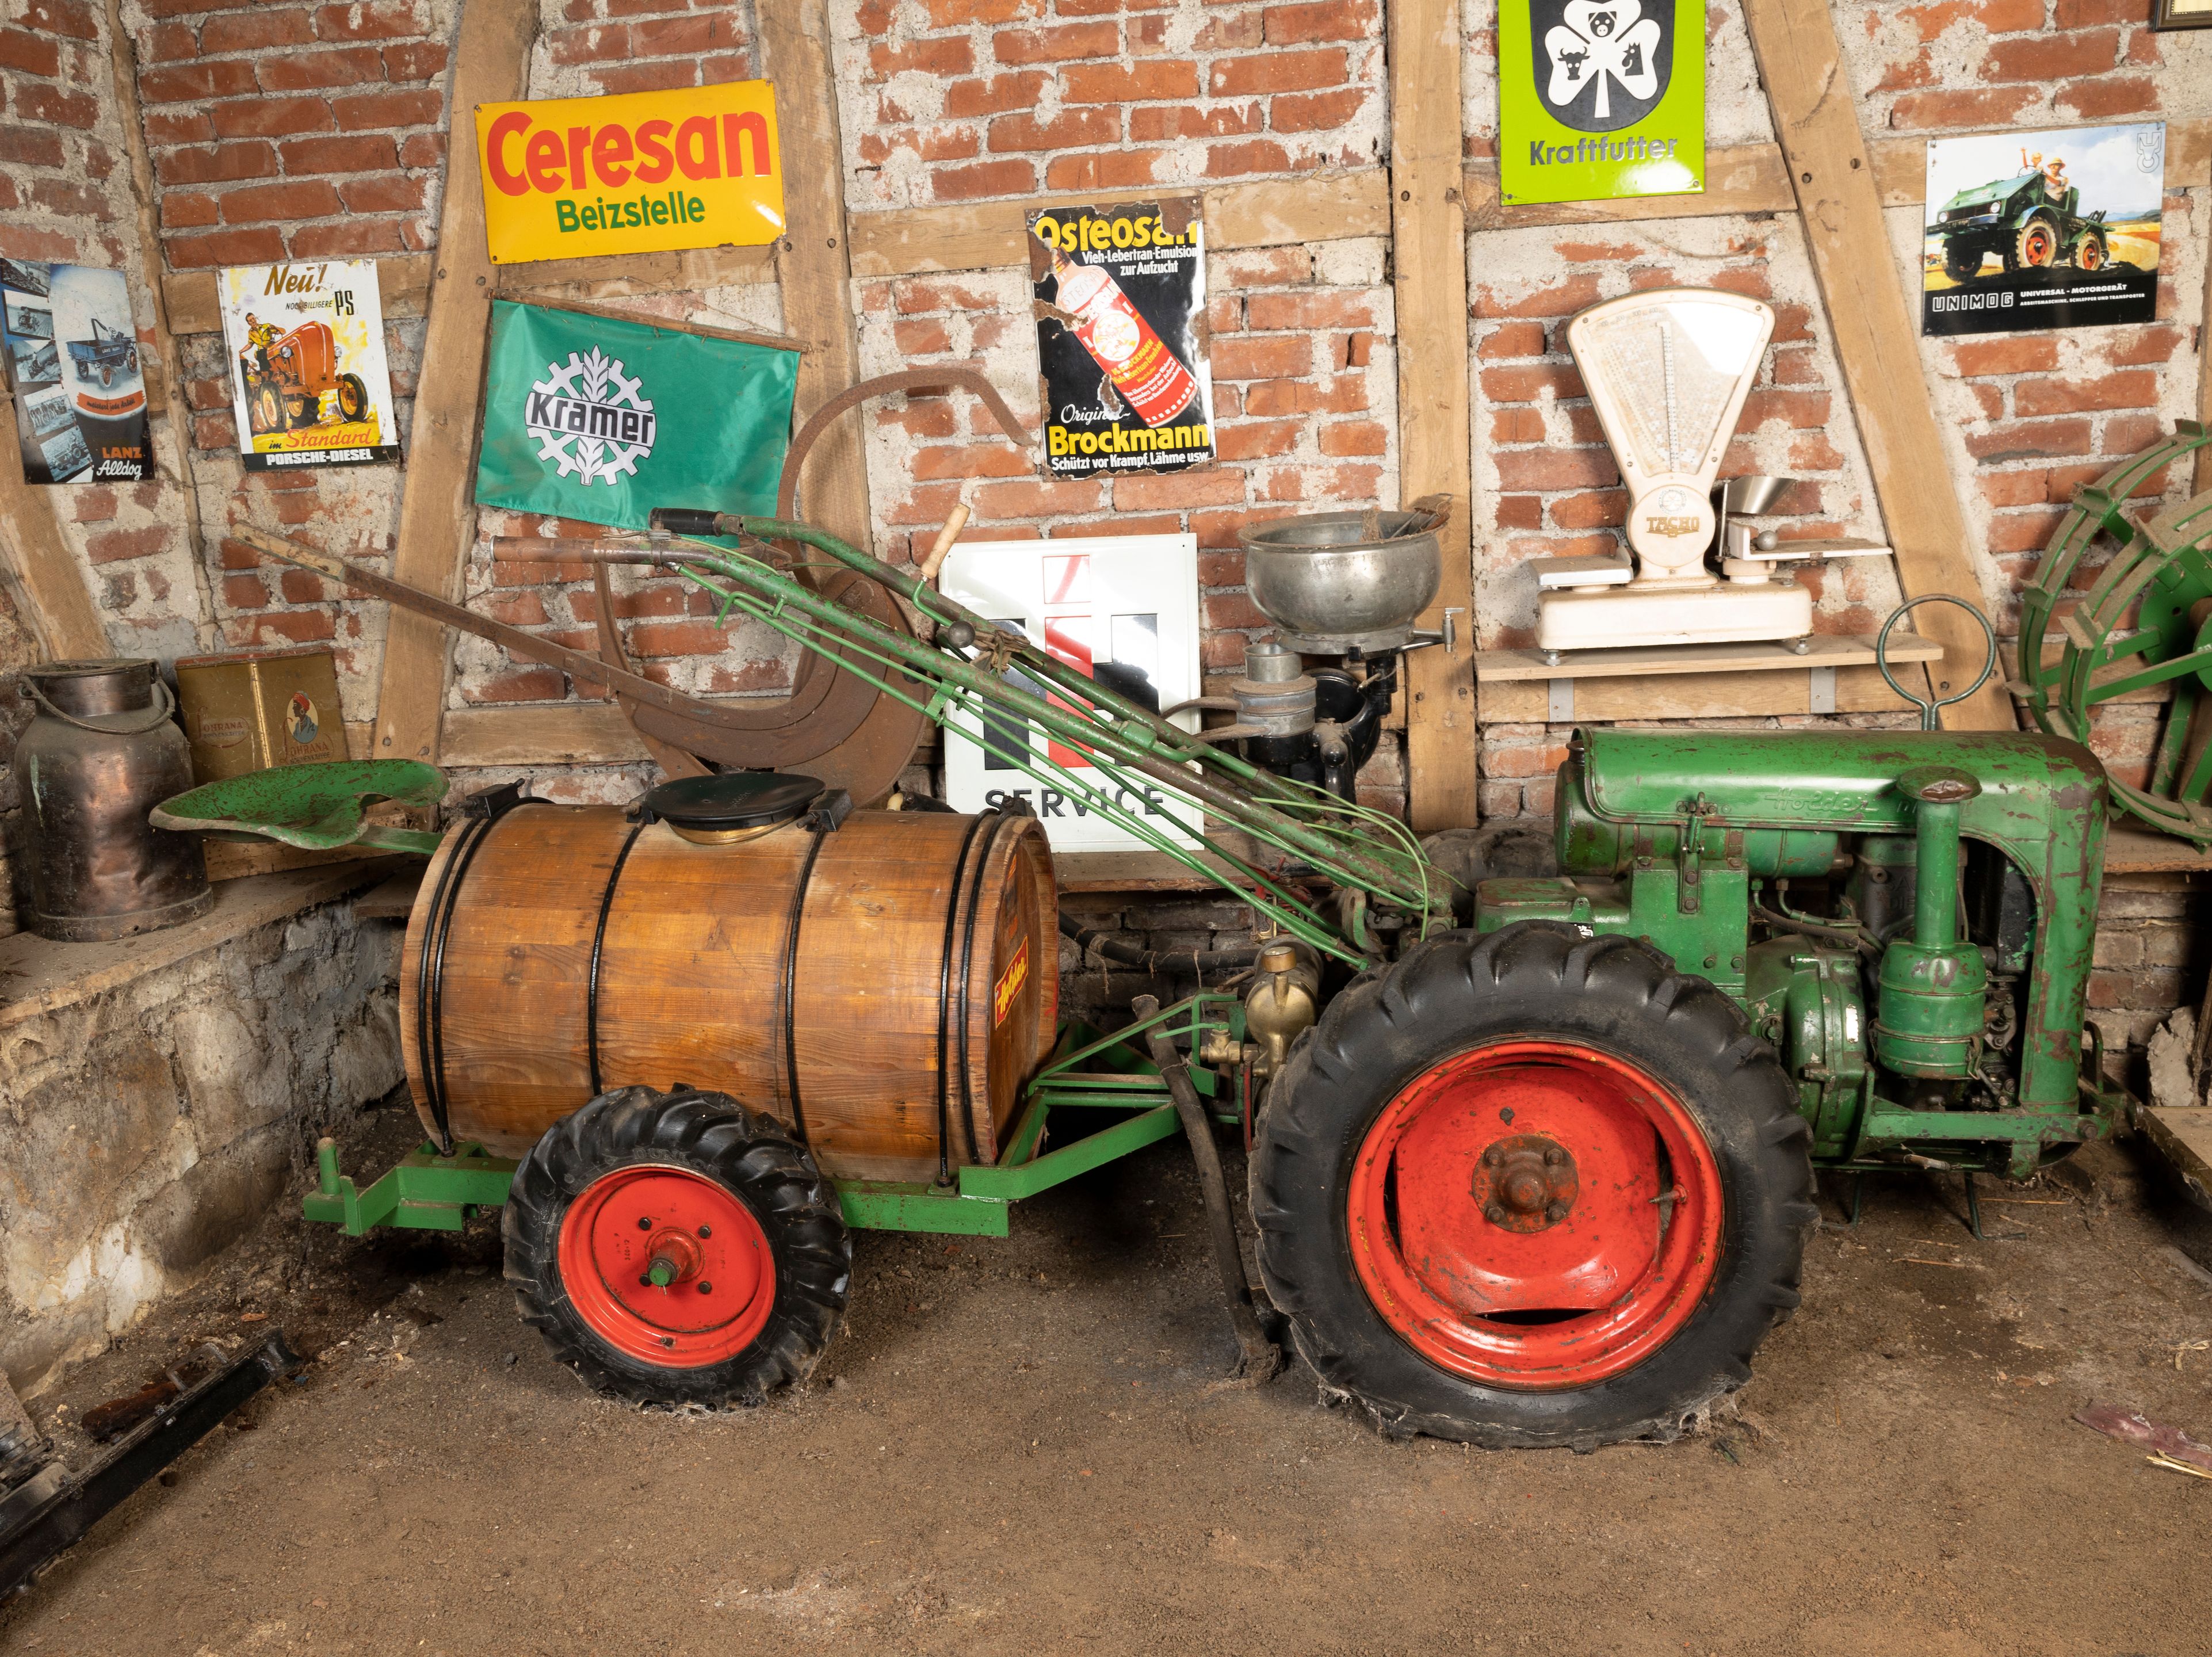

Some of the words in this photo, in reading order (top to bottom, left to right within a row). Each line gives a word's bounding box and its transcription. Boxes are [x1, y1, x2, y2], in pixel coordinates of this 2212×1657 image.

[487, 110, 771, 197] Ceresan
[1530, 135, 1678, 166] Kraftfutter
[555, 190, 705, 233] Beizstelle
[1120, 264, 1137, 277] zur
[1137, 259, 1179, 275] Aufzucht
[2020, 288, 2065, 298] UNIVERSAL
[2071, 282, 2127, 294] MOTORGERÄT
[303, 300, 333, 310] BILLIGERE
[334, 290, 354, 316] PS
[1932, 292, 2014, 312] UNIMOG
[530, 392, 654, 445] Kramer
[1060, 403, 1131, 425] Originl-
[268, 440, 283, 450] im
[286, 428, 374, 449] Standard
[1049, 422, 1210, 456] Brockmann
[102, 446, 143, 459] LANZ
[266, 448, 374, 466] PORSCHE-DIESEL
[1052, 456, 1091, 471] Schützt
[1091, 458, 1109, 469] vor
[1150, 450, 1188, 465] Lähme
[96, 459, 143, 481] Alldog
[1646, 516, 1699, 532] TACHO
[1764, 786, 1879, 813] Holder
[997, 957, 1026, 1014] Holder
[632, 1147, 720, 1176] DUNLOP
